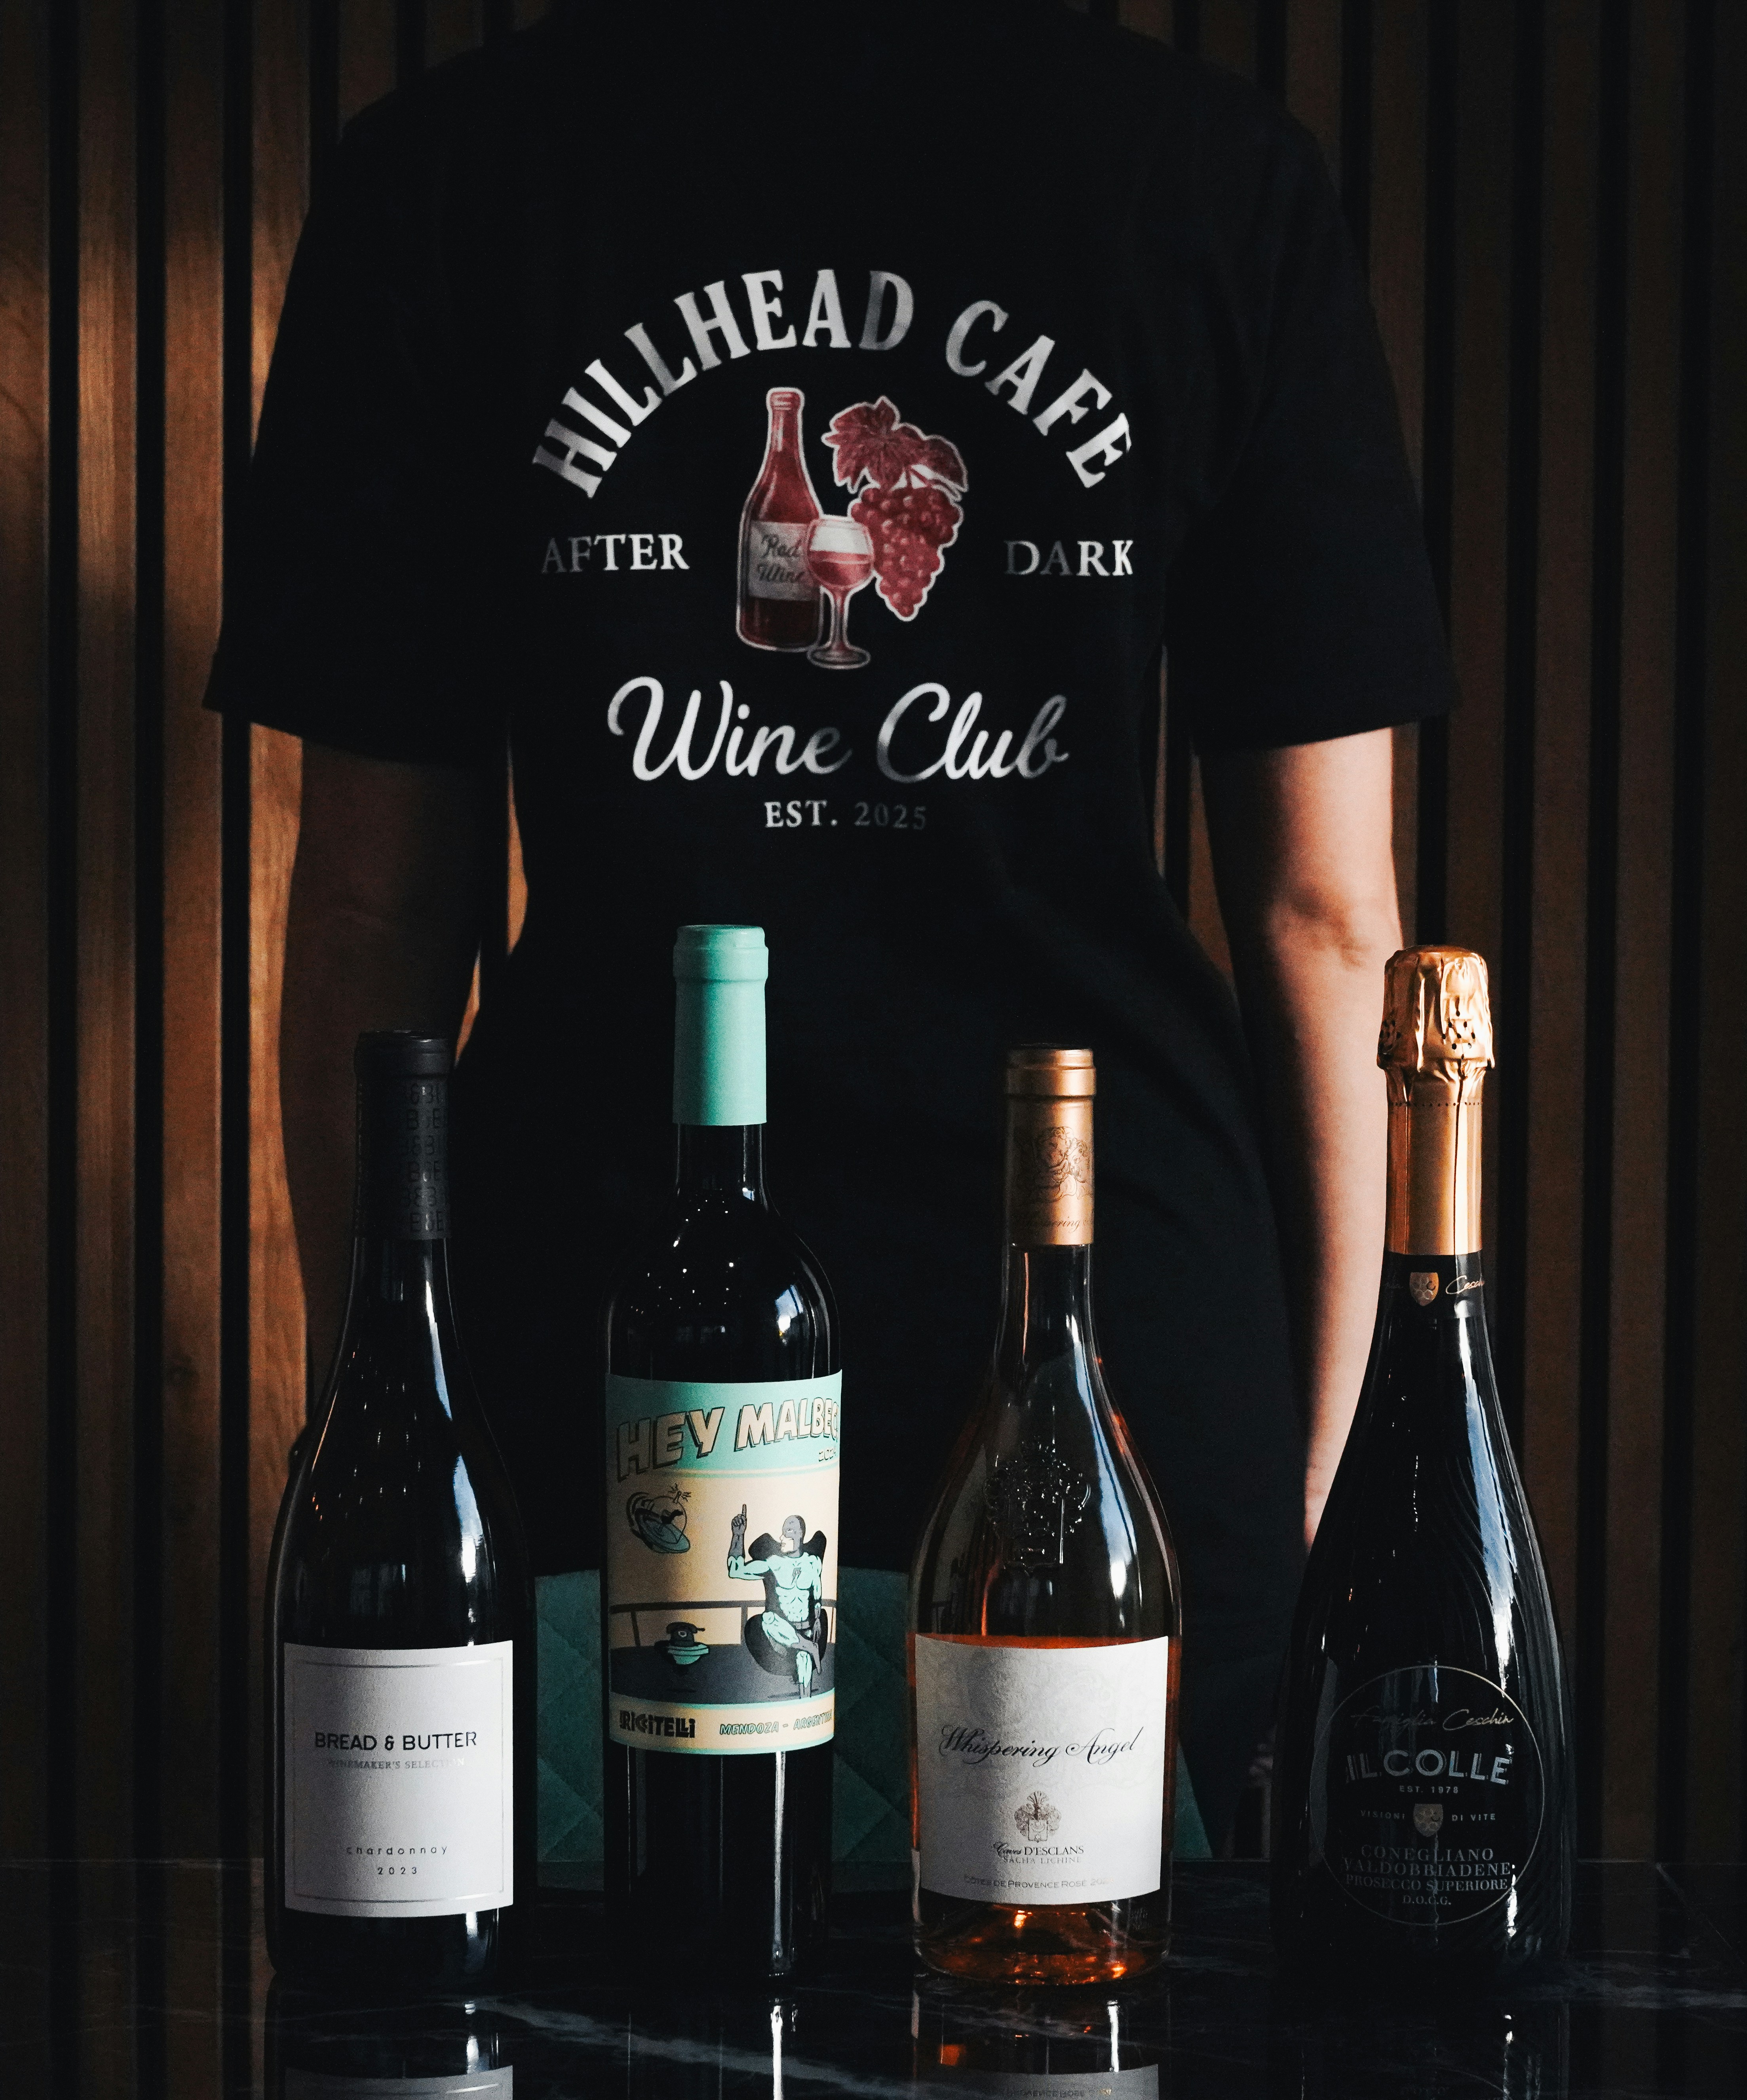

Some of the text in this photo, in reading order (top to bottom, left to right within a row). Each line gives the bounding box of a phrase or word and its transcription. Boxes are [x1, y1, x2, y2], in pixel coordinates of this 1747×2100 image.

[532, 269, 1132, 498] HILLHEAD CAFE
[541, 533, 690, 574] AFTER
[761, 534, 802, 558] Red
[1004, 540, 1133, 576] DARK
[608, 676, 1068, 784] Wine Club
[764, 800, 926, 831] EST. 2025
[617, 1407, 724, 1482] HEY
[720, 1721, 779, 1735] MENDOZA
[315, 1731, 477, 1751] BREAD & BUTTER
[939, 1725, 1144, 1767] Whispering Angel
[1384, 1749, 1509, 1785] COLLE
[1361, 1810, 1405, 1819] VISIONI
[346, 1846, 447, 1855] chardonnay
[1024, 1845, 1084, 1855] D'ESCLANS
[1361, 1845, 1494, 1861] CONEGLIANO
[1342, 1857, 1510, 1877] VALDOBBIADENE
[1008, 1879, 1059, 1889] PROVENCE
[1346, 1874, 1507, 1892] PROSECCO SUPERIORE
